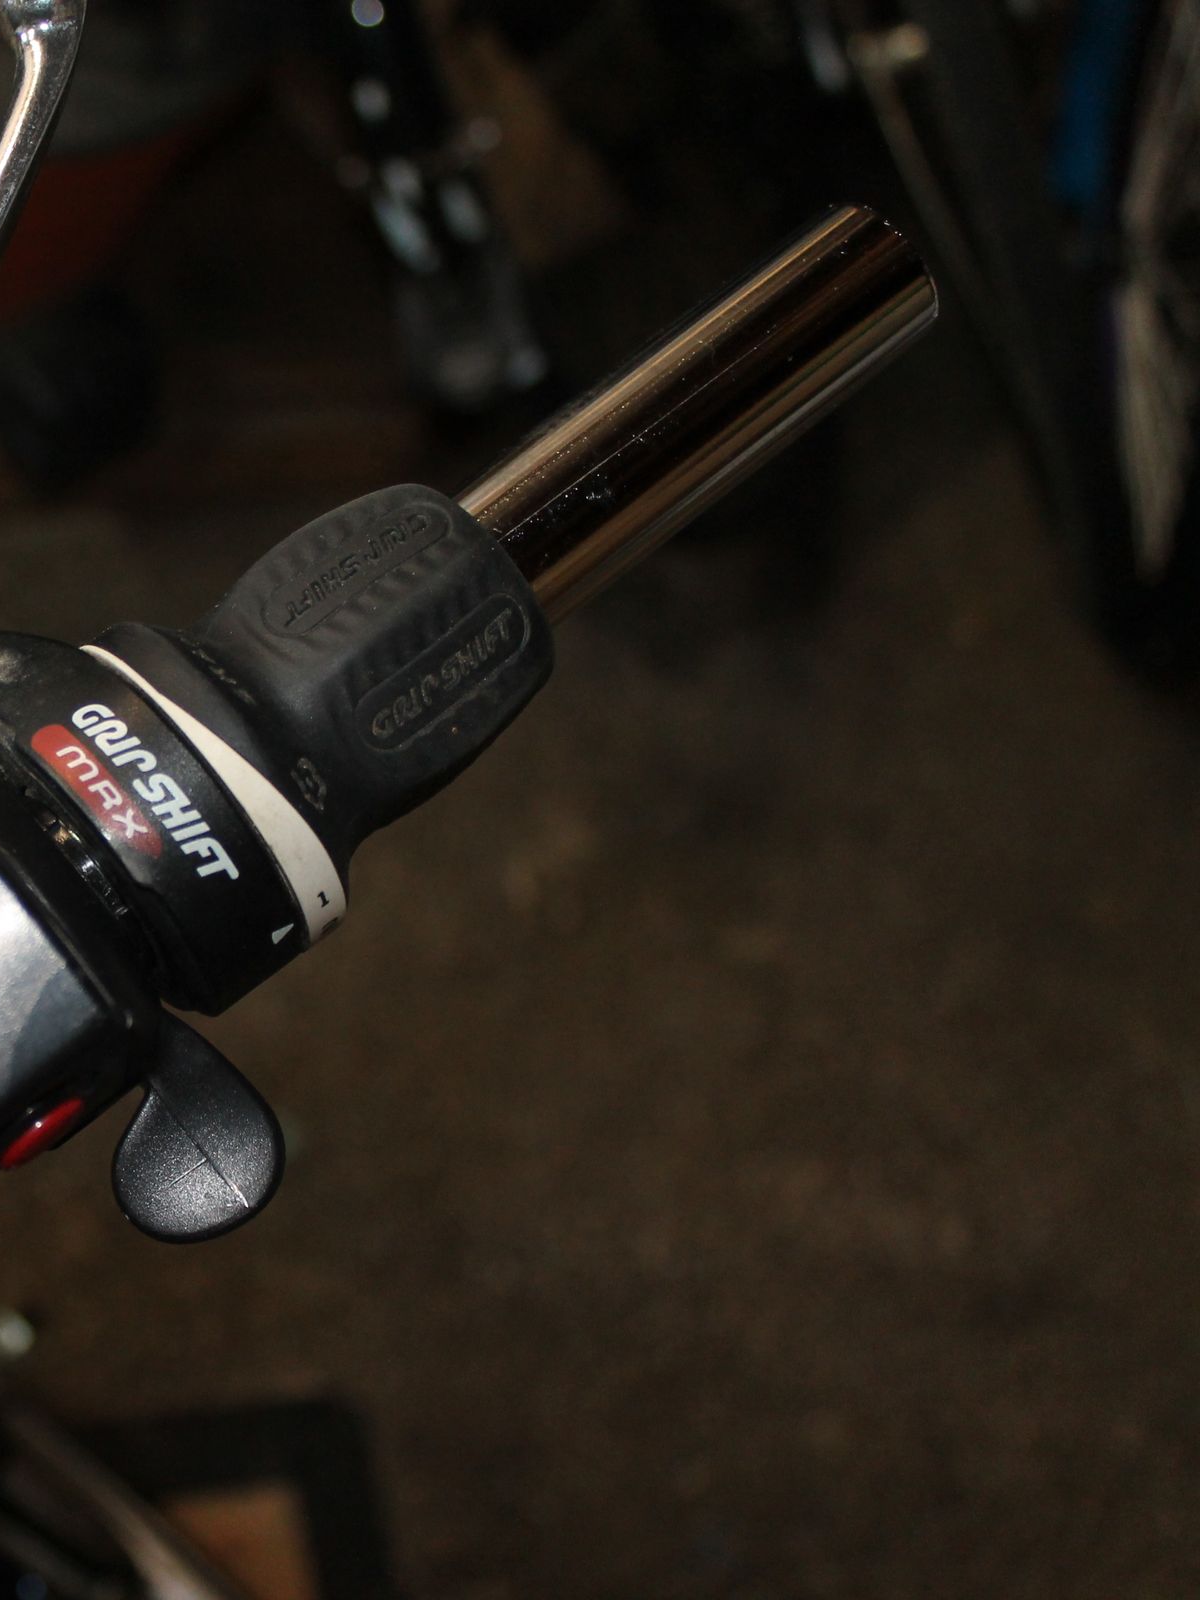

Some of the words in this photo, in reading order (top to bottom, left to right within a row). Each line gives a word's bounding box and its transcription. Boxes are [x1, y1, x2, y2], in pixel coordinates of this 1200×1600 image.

[439, 607, 514, 692] SHIFT
[71, 702, 157, 773] GRIP
[131, 772, 240, 881] SHIFT
